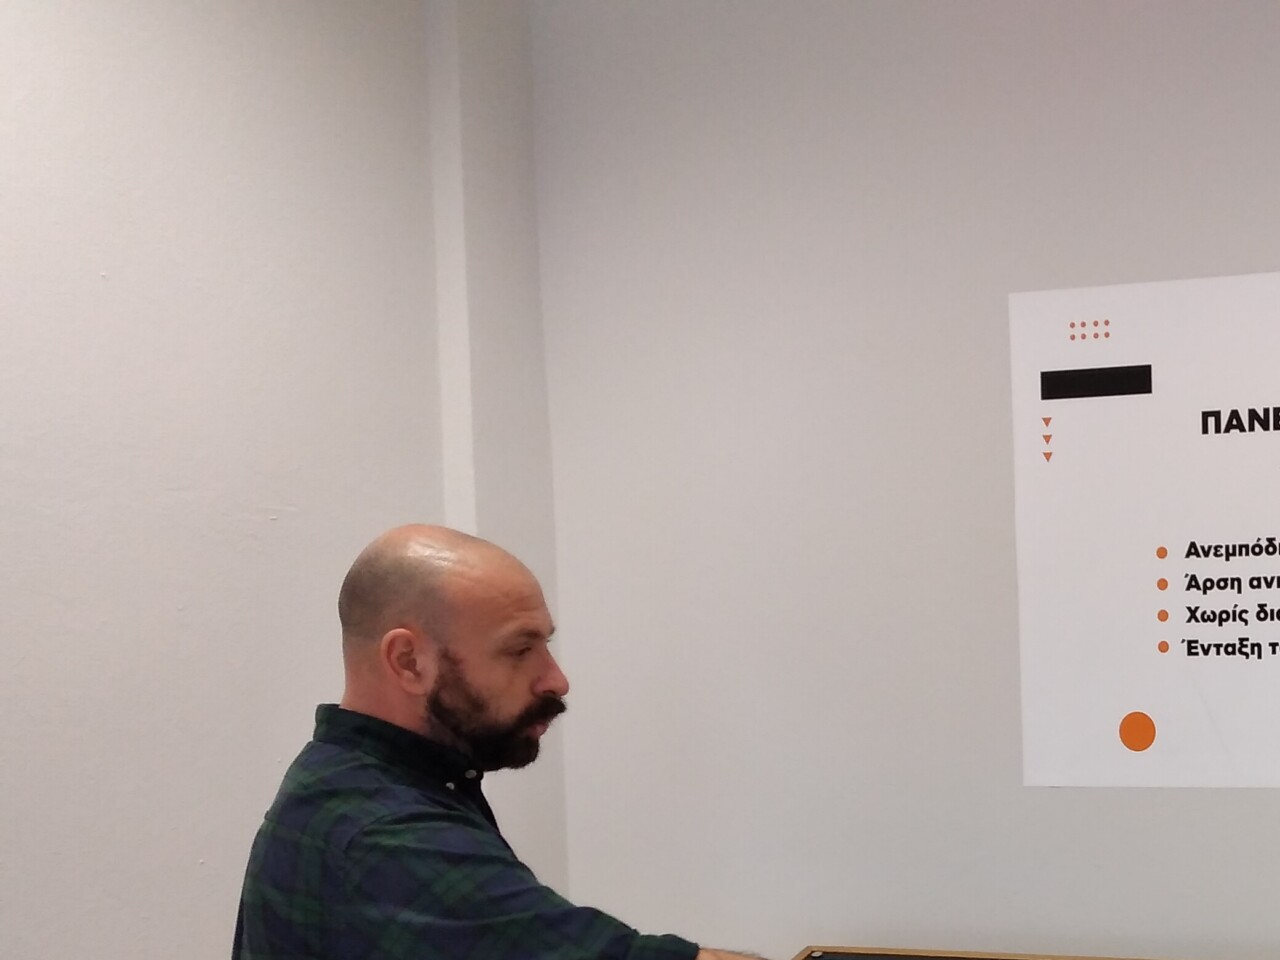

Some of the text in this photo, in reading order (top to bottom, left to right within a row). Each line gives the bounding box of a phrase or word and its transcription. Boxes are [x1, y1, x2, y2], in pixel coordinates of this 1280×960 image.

[1185, 573, 1242, 595] Άρση
[1186, 606, 1249, 627] Χωρίς
[1181, 638, 1262, 659] Ένταξη
